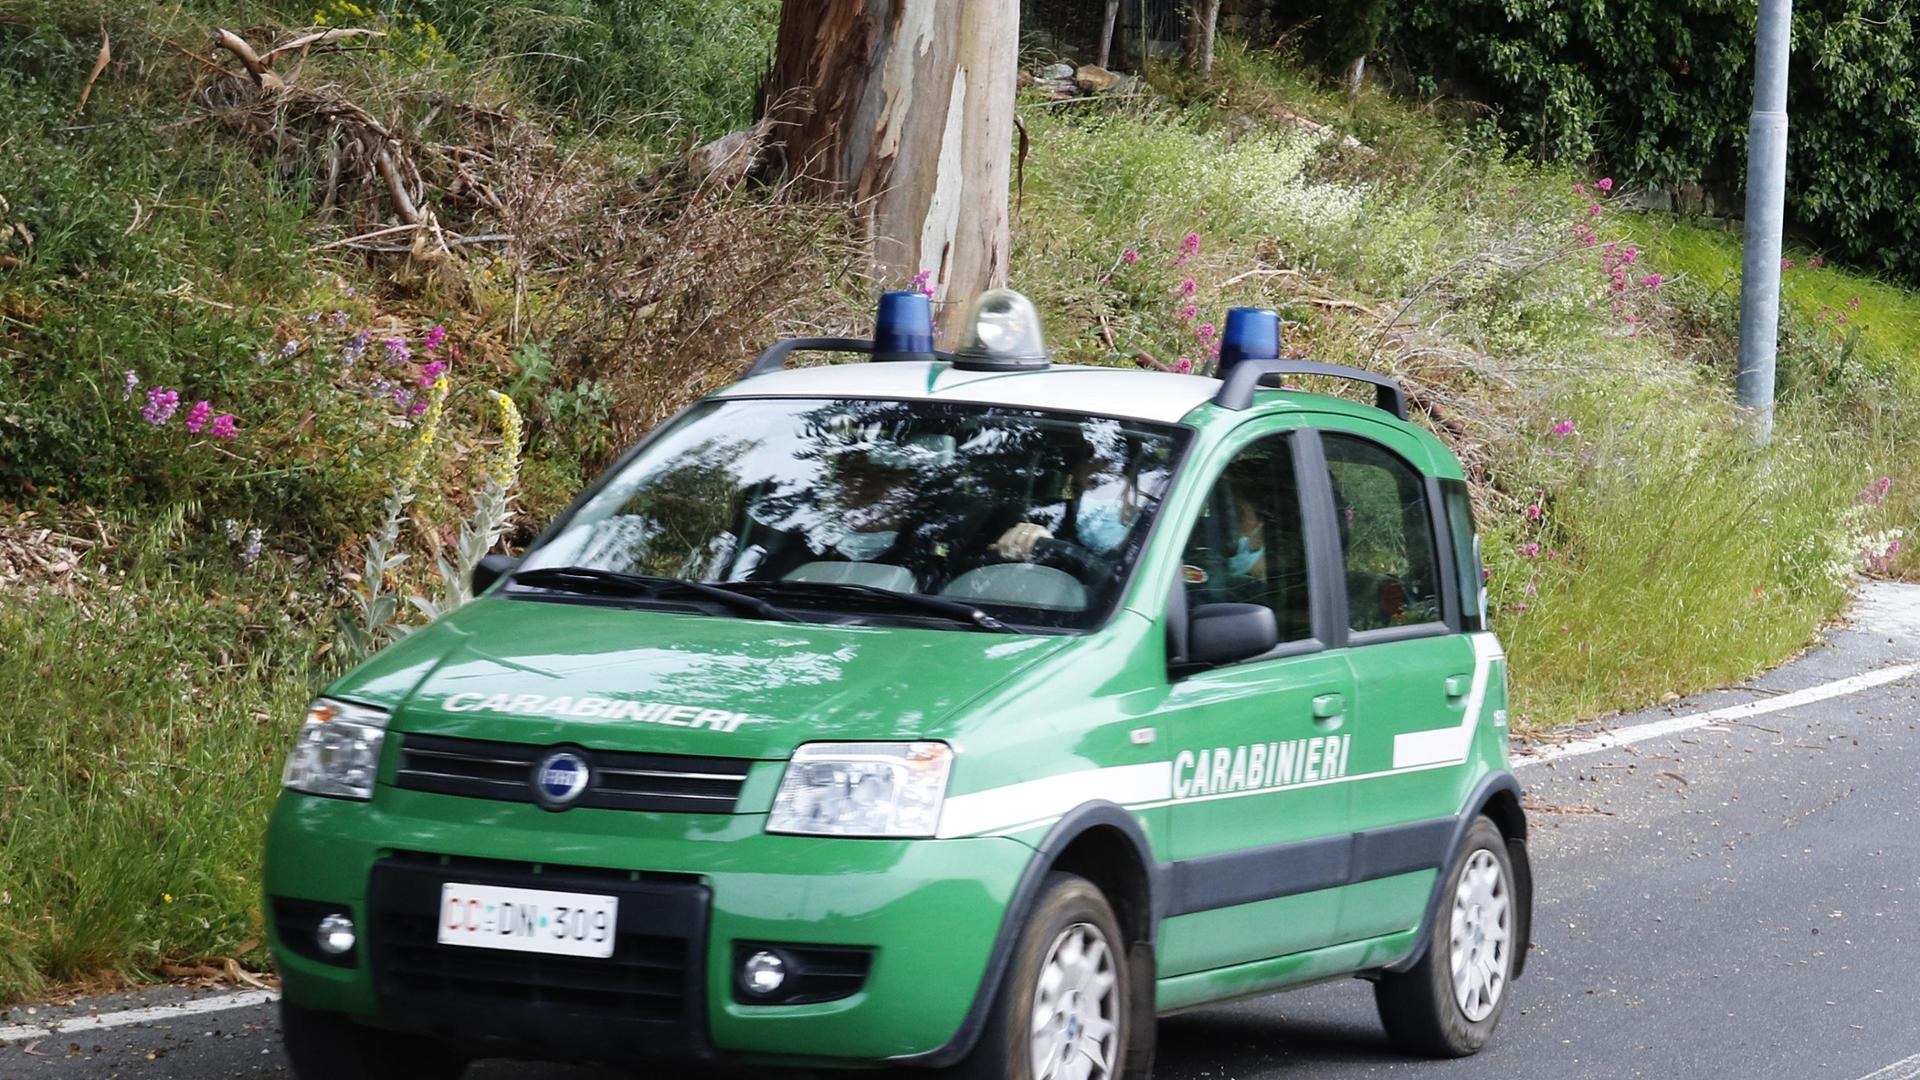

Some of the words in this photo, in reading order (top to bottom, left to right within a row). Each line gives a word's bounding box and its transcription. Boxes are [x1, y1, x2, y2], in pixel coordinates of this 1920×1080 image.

[441, 692, 751, 733] CARABINIERI
[1173, 734, 1351, 799] CARABINIERI
[499, 902, 537, 937] DN
[552, 906, 609, 943] 309
